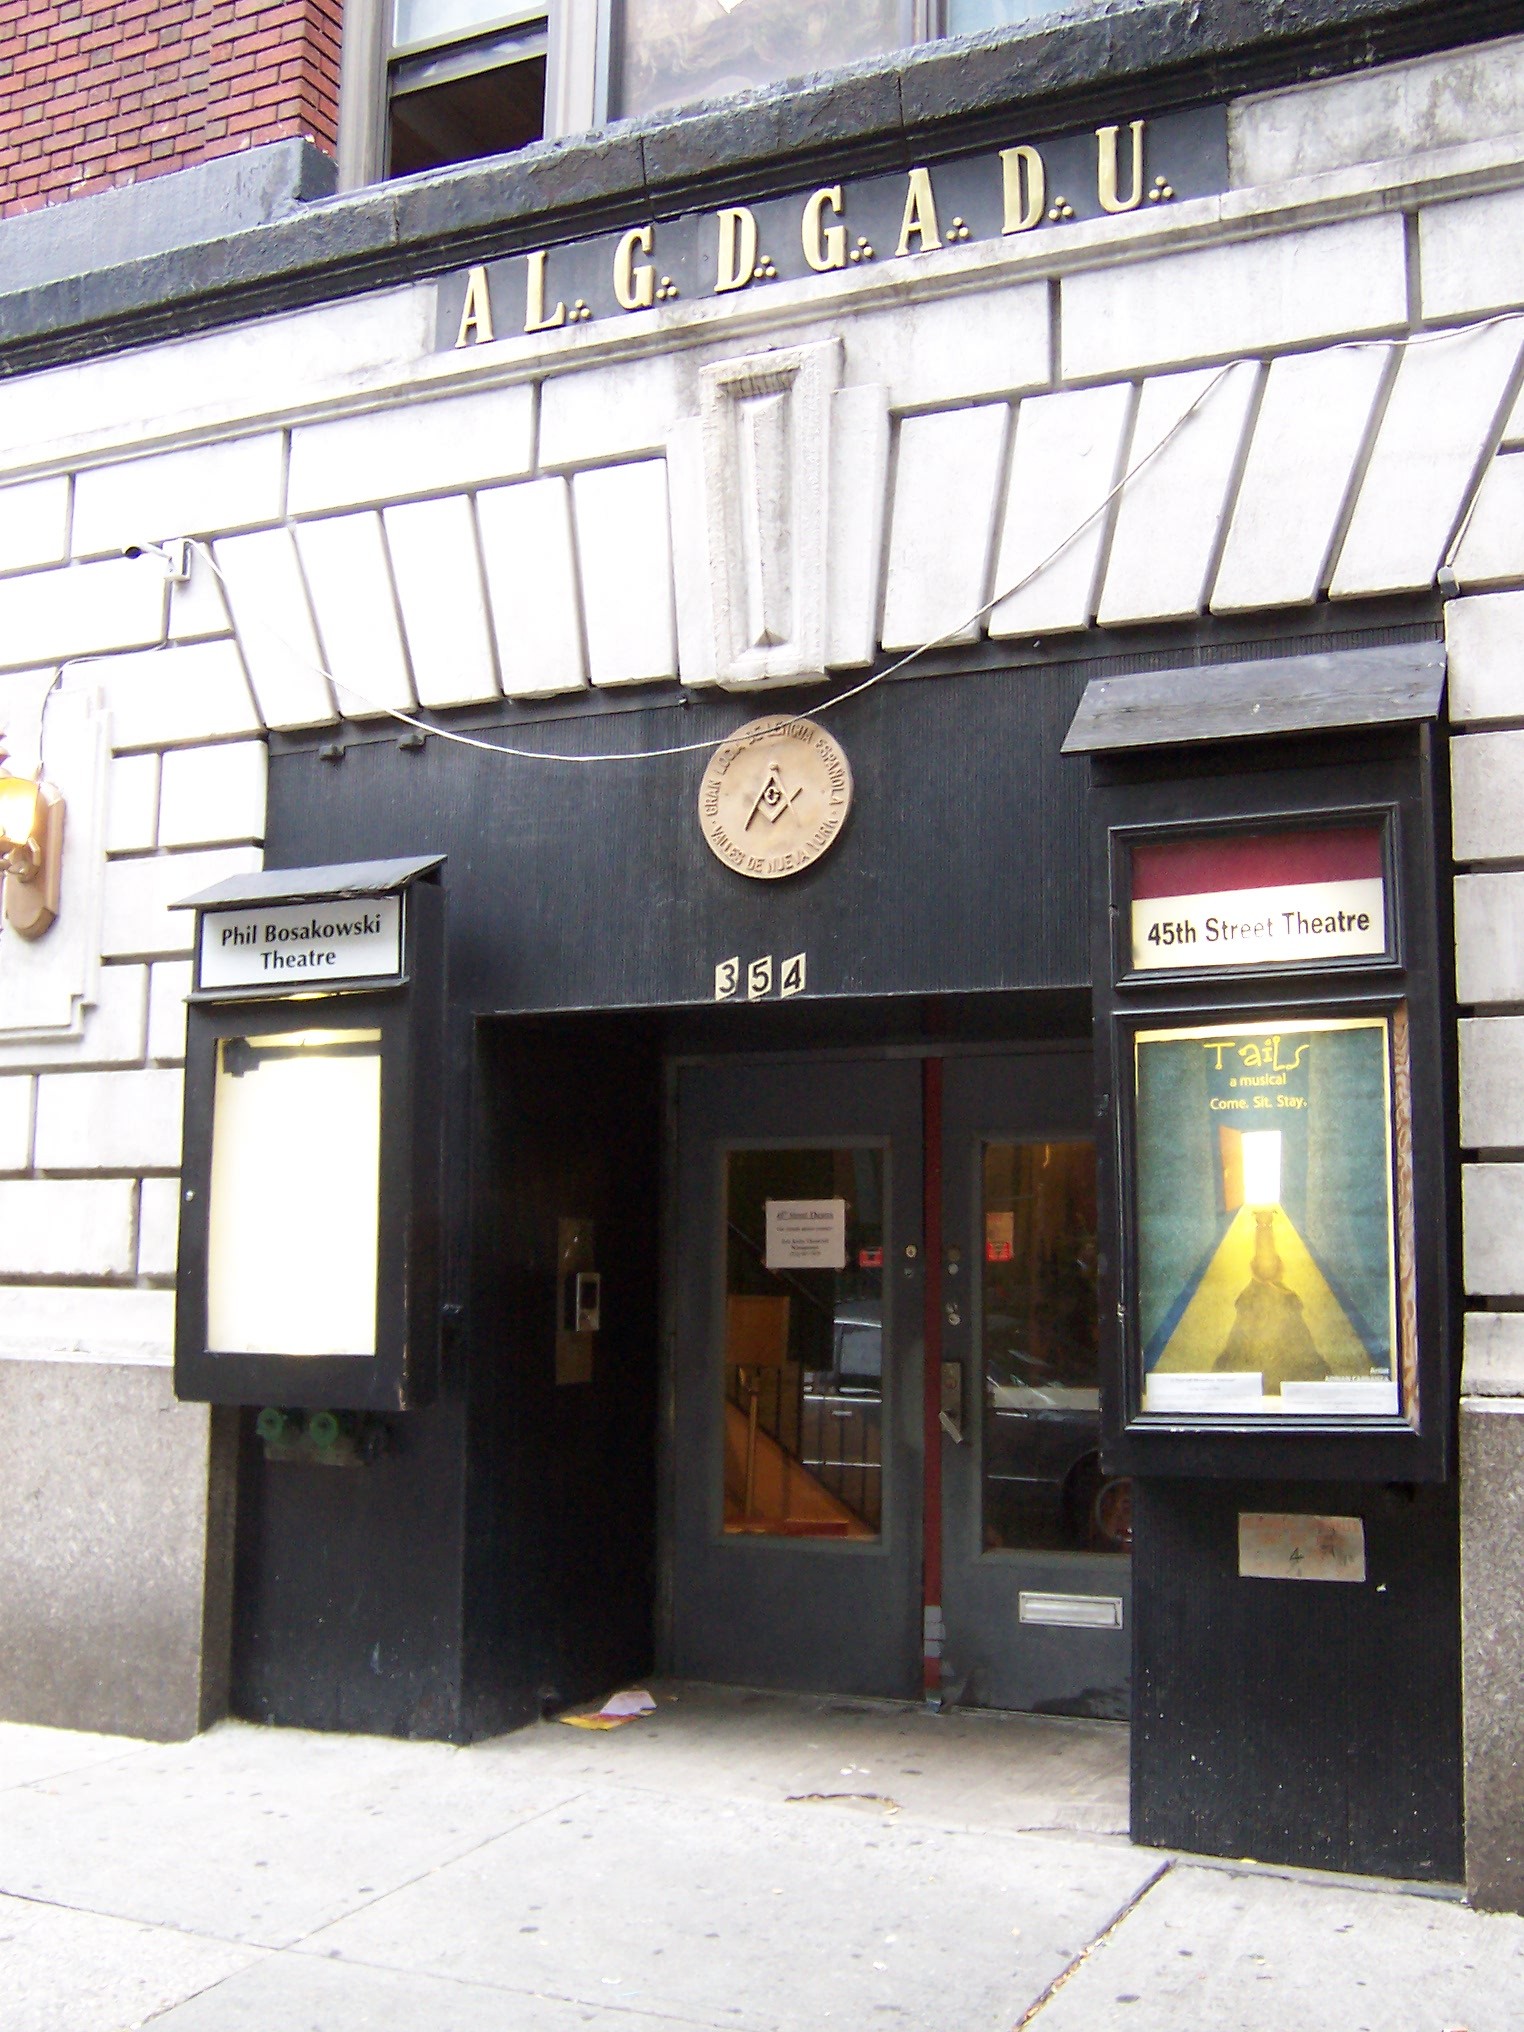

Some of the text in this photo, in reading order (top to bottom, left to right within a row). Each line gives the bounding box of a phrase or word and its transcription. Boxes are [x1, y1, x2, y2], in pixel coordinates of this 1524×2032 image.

[704, 779, 721, 817] GRAN
[711, 825, 745, 866] VALLES
[747, 856, 765, 873] DE
[221, 913, 382, 947] Phil Bosakowski
[1148, 910, 1370, 946] 45th Street Theatre
[260, 950, 337, 970] Theatre
[1229, 1073, 1287, 1088] a musical
[1210, 1095, 1308, 1110] Come. Sit. Stay.
